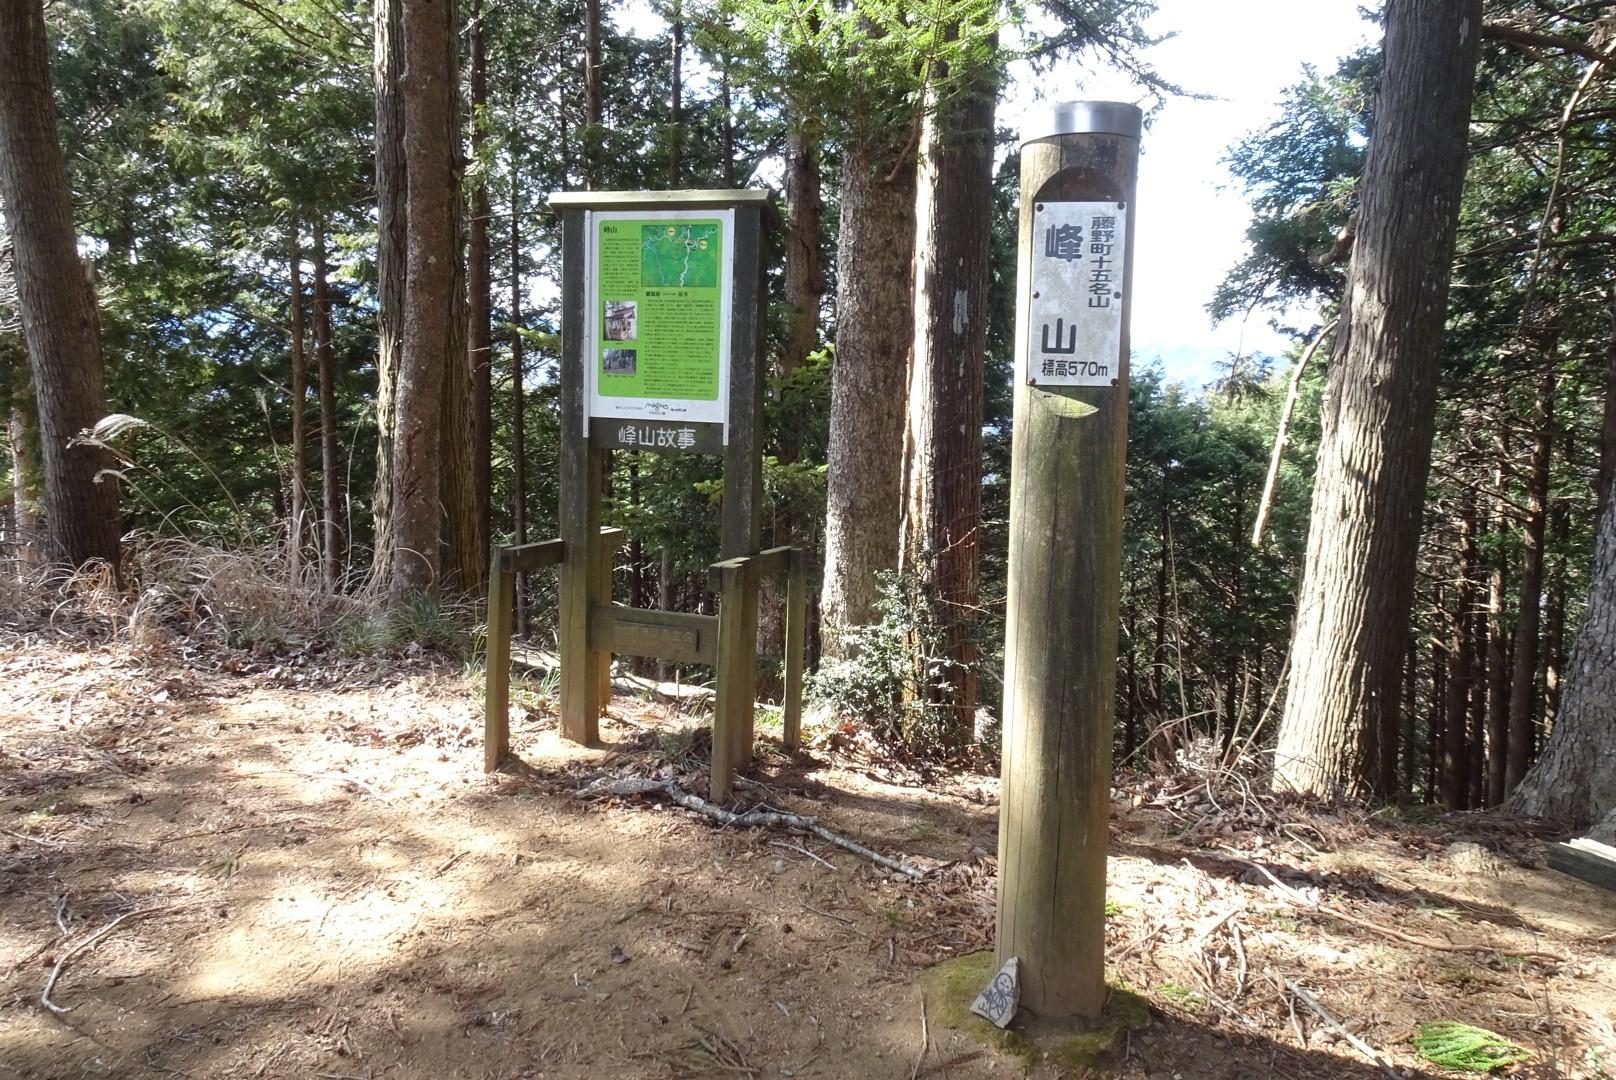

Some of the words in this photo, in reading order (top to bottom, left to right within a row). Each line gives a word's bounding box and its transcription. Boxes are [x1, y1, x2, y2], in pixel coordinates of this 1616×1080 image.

[1088, 216, 1116, 308] 藤野町十五名山
[1041, 359, 1108, 377] 標高570m
[618, 425, 696, 449] 峰山故事
